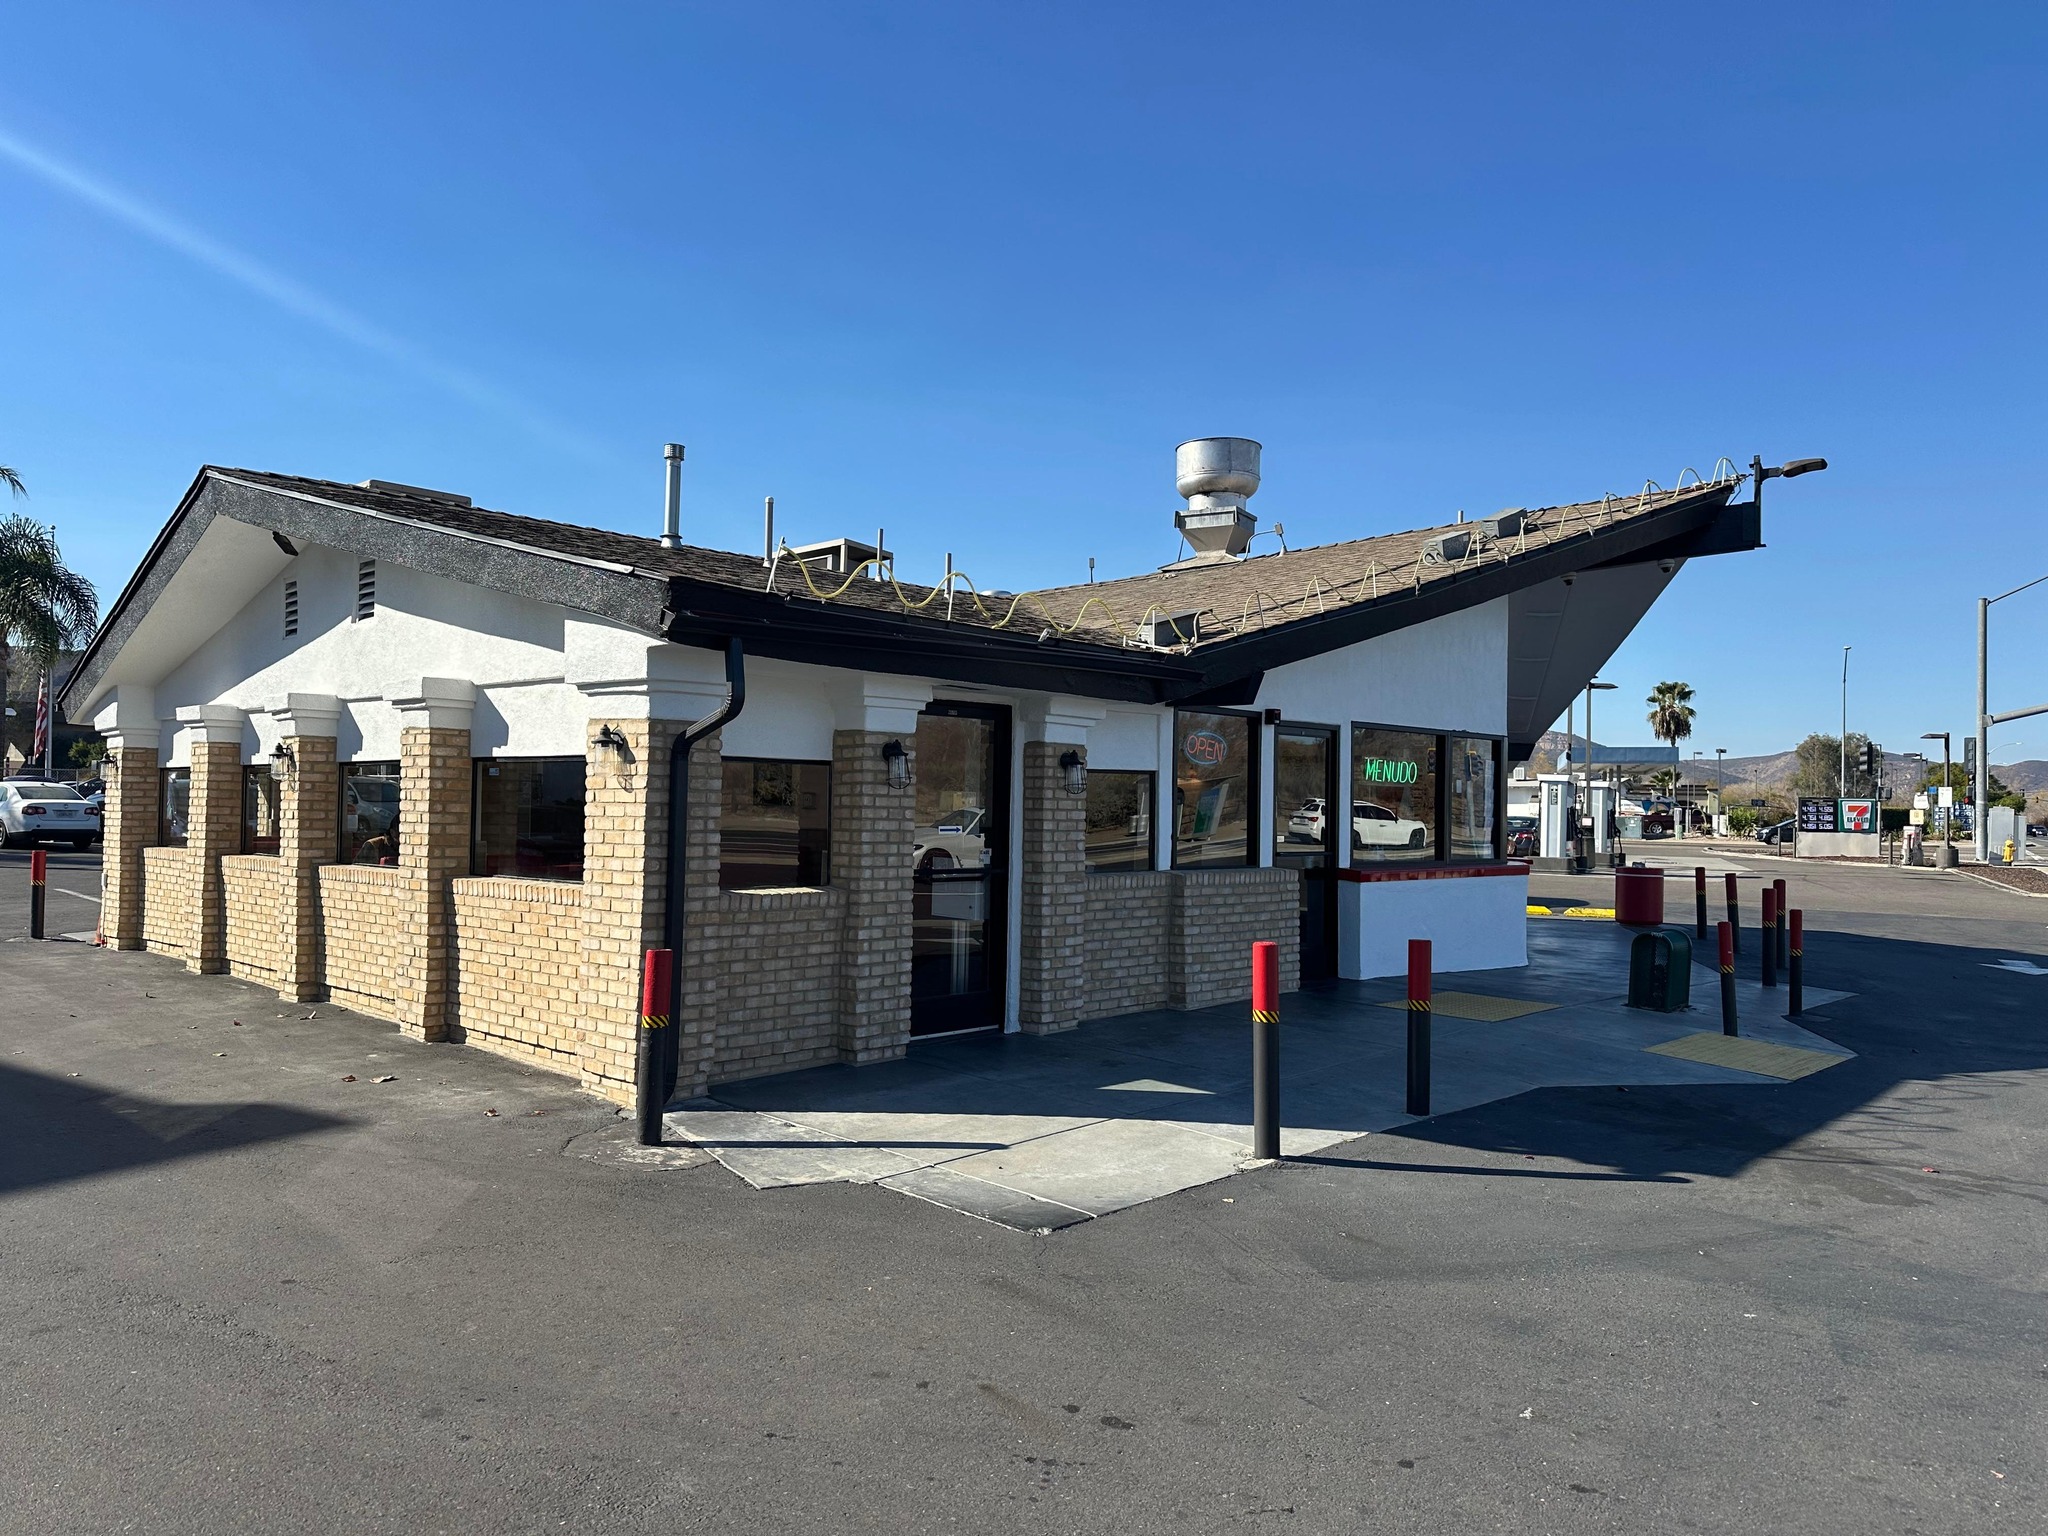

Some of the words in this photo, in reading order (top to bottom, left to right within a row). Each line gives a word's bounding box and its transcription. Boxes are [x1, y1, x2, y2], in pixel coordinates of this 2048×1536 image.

[1187, 735, 1224, 762] OPEN
[1366, 758, 1418, 784] MENUDO
[1847, 804, 1869, 830] 7
